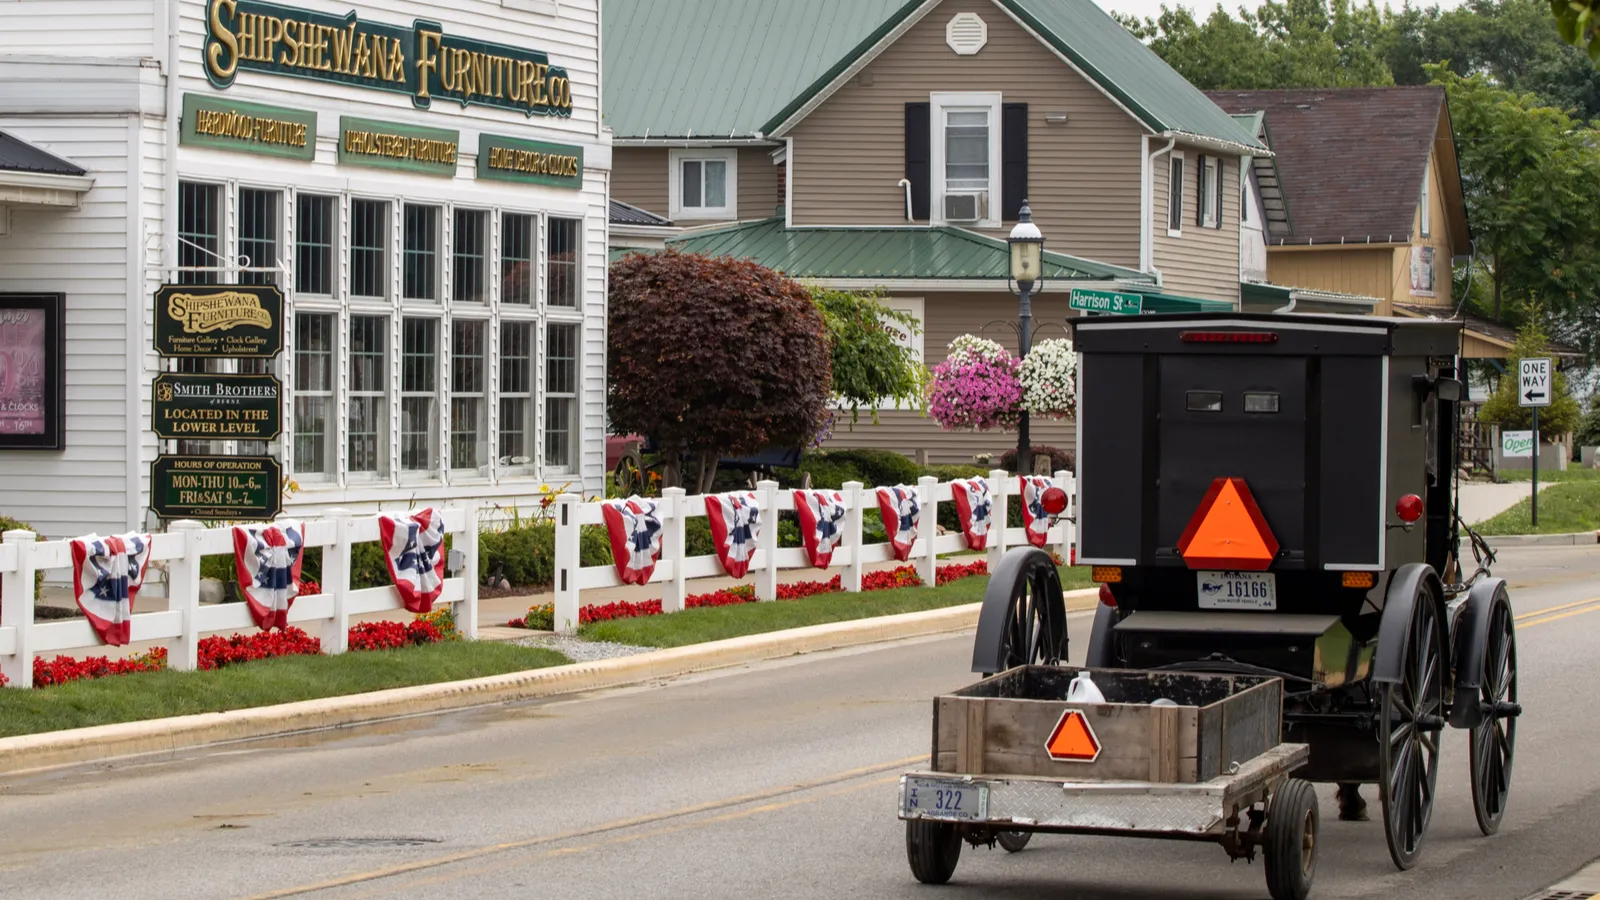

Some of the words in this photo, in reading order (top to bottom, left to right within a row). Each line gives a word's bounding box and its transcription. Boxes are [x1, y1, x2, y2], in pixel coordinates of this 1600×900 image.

[208, 0, 406, 83] SHIPSHEWANA
[416, 29, 549, 107] FURNITURE
[549, 76, 573, 108] CO.
[196, 109, 253, 139] HARDWOOD
[253, 117, 308, 147] FURNITURE
[345, 129, 409, 158] UPHOLSTERED
[409, 137, 457, 164] FURNITURE
[489, 147, 514, 169] HOME
[514, 149, 540, 174] DECOR
[540, 153, 548, 173] &
[548, 153, 578, 177] CLOCKS
[171, 296, 257, 318] SHIPSHEWANA
[1072, 290, 1110, 309] Harrison
[1113, 295, 1123, 311] St
[187, 307, 257, 329] FURNITURE
[168, 335, 196, 344] Furniture
[196, 335, 220, 345] Gallery
[226, 336, 244, 345] Clock
[244, 336, 268, 346] Gallery
[173, 344, 193, 353] Home
[193, 345, 212, 353] Decor
[222, 345, 259, 354] Upholstered
[1523, 363, 1546, 374] ONE
[1522, 376, 1546, 387] WAY
[174, 382, 210, 396] SMITH
[216, 383, 277, 397] BROTHERS
[164, 408, 223, 420] LOCATED
[226, 409, 240, 420] IN
[242, 410, 269, 421] THE
[172, 421, 217, 433] LOWER
[220, 422, 259, 434] LEVEL
[174, 460, 202, 469] HOURS
[203, 461, 215, 469] OF
[216, 462, 262, 470] OPERATION
[172, 475, 225, 489] MON-THU
[179, 491, 224, 504] FRI&SAT
[194, 508, 215, 516] Closed
[215, 509, 238, 517] Sundays
[1227, 581, 1267, 598] 16166
[936, 790, 962, 810] 322
